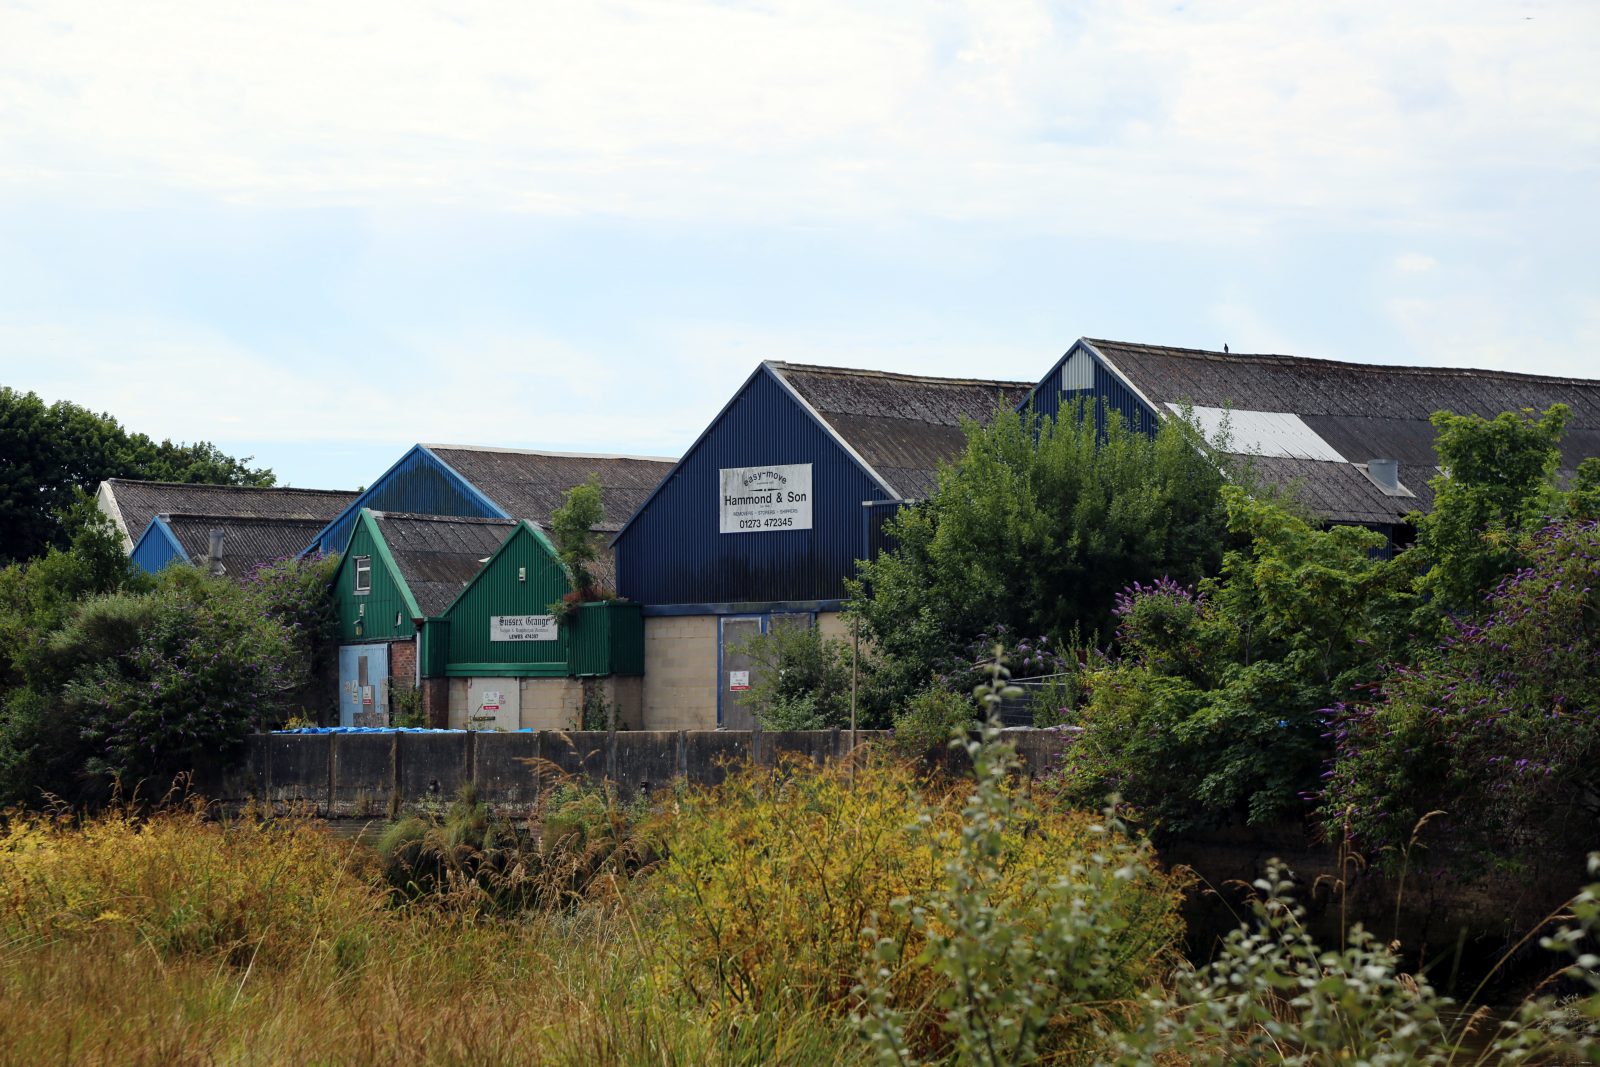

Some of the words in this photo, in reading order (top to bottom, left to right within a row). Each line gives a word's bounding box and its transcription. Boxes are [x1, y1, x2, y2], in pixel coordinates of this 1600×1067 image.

[743, 471, 787, 487] easy-move
[725, 493, 772, 506] Hammond
[776, 492, 783, 503] &
[787, 491, 806, 503] Son
[740, 519, 761, 529] 01273
[764, 518, 793, 527] 472345
[499, 616, 522, 626] Sussex
[525, 616, 549, 627] Grange
